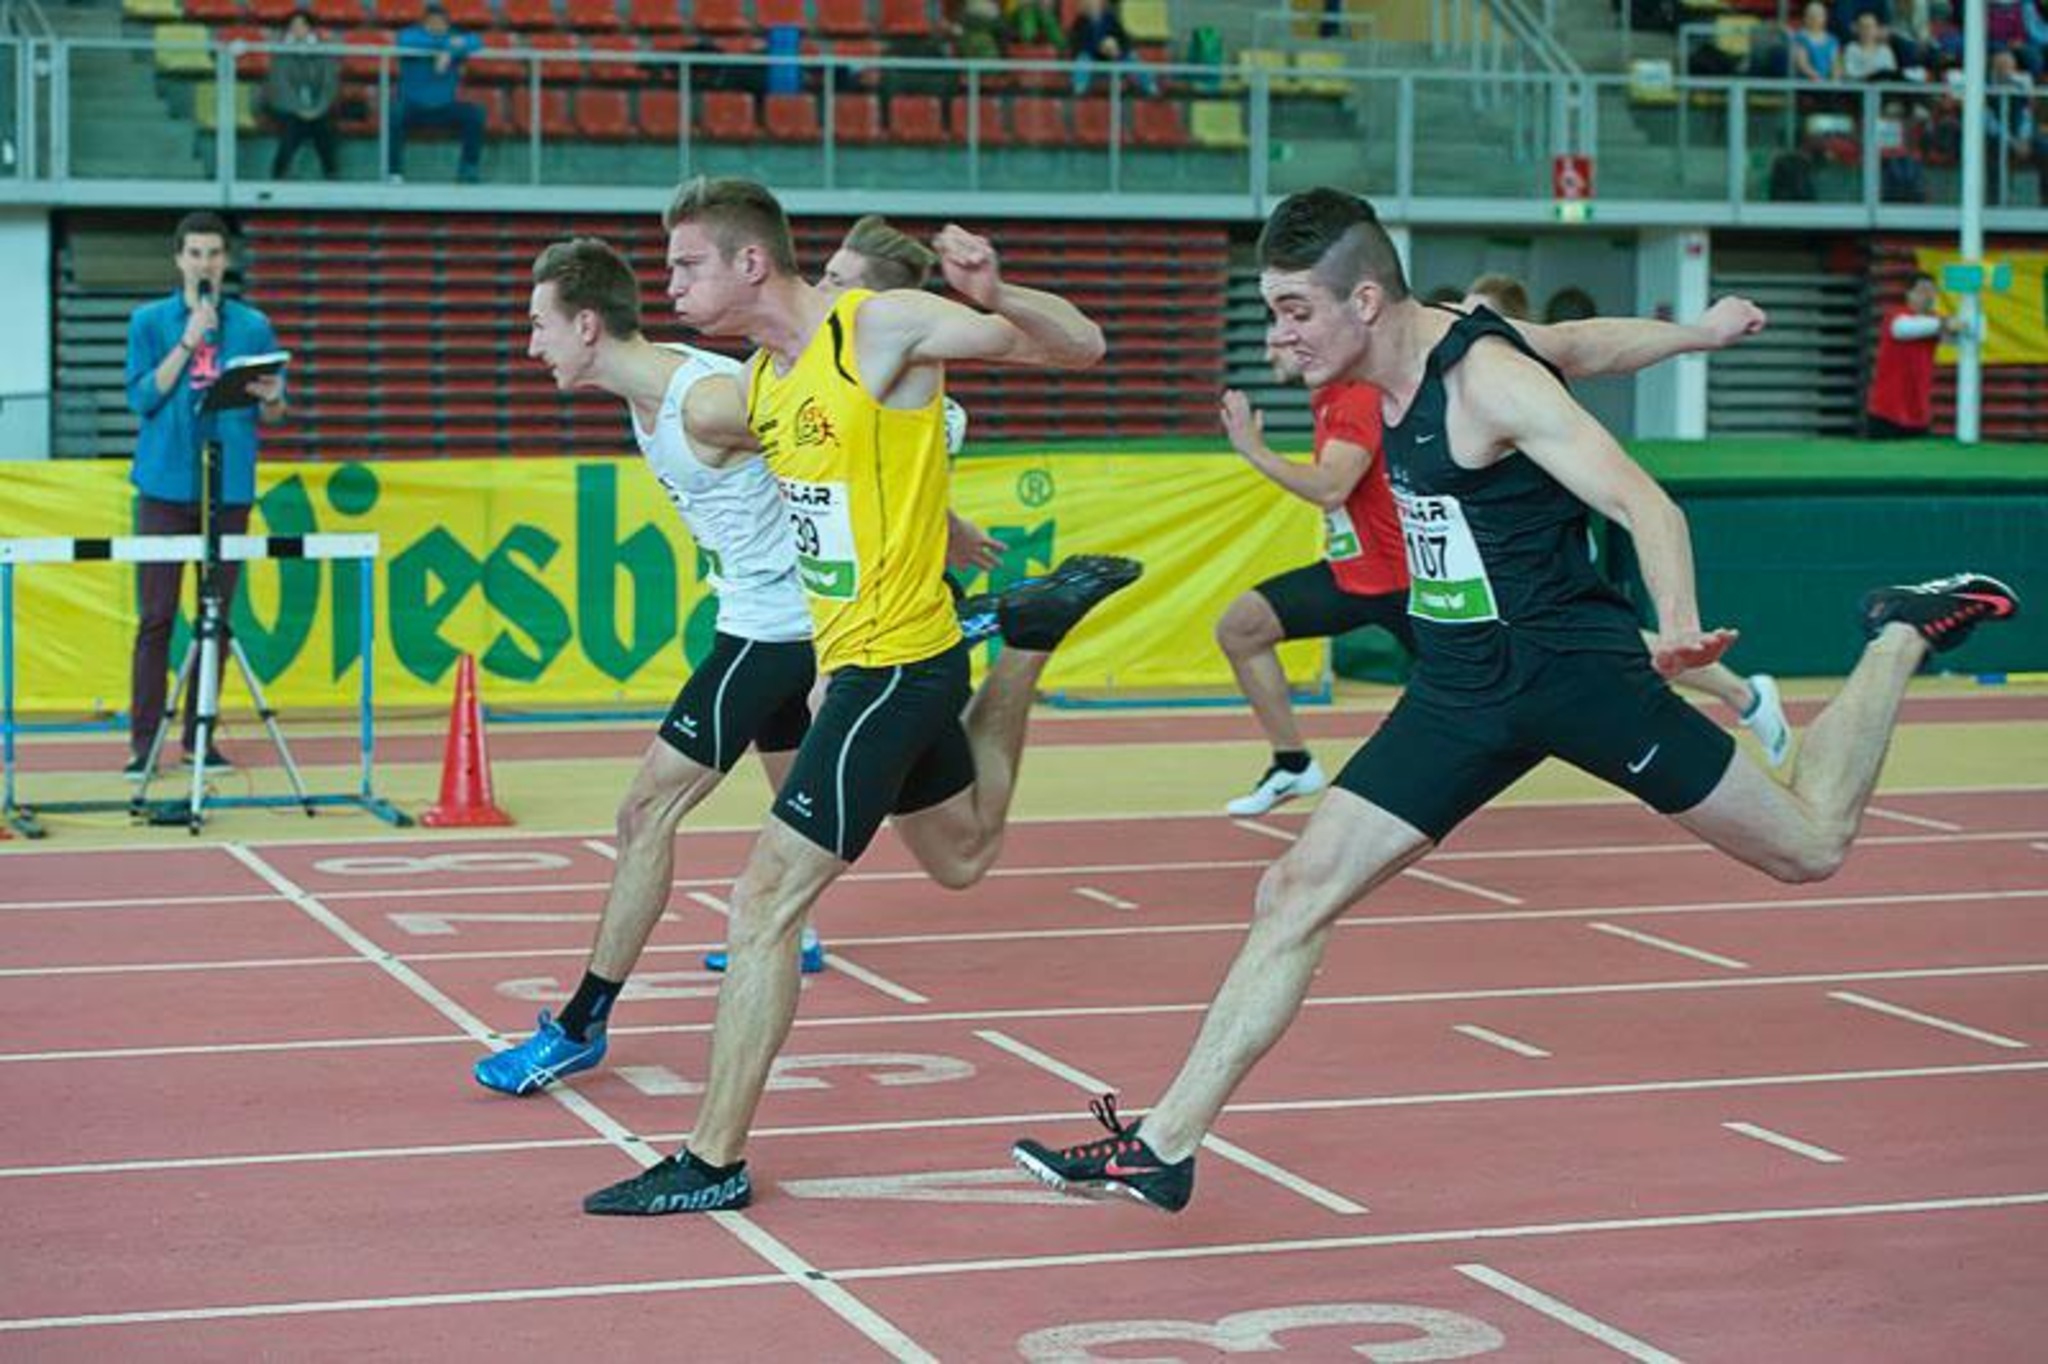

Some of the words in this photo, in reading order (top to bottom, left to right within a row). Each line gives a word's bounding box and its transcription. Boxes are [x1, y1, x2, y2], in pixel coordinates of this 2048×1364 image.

[788, 513, 820, 557] 39
[1407, 531, 1447, 579] 107
[313, 851, 573, 875] 8
[388, 911, 683, 936] 7
[612, 1052, 977, 1096] 5
[649, 1173, 749, 1212] ADIDAS
